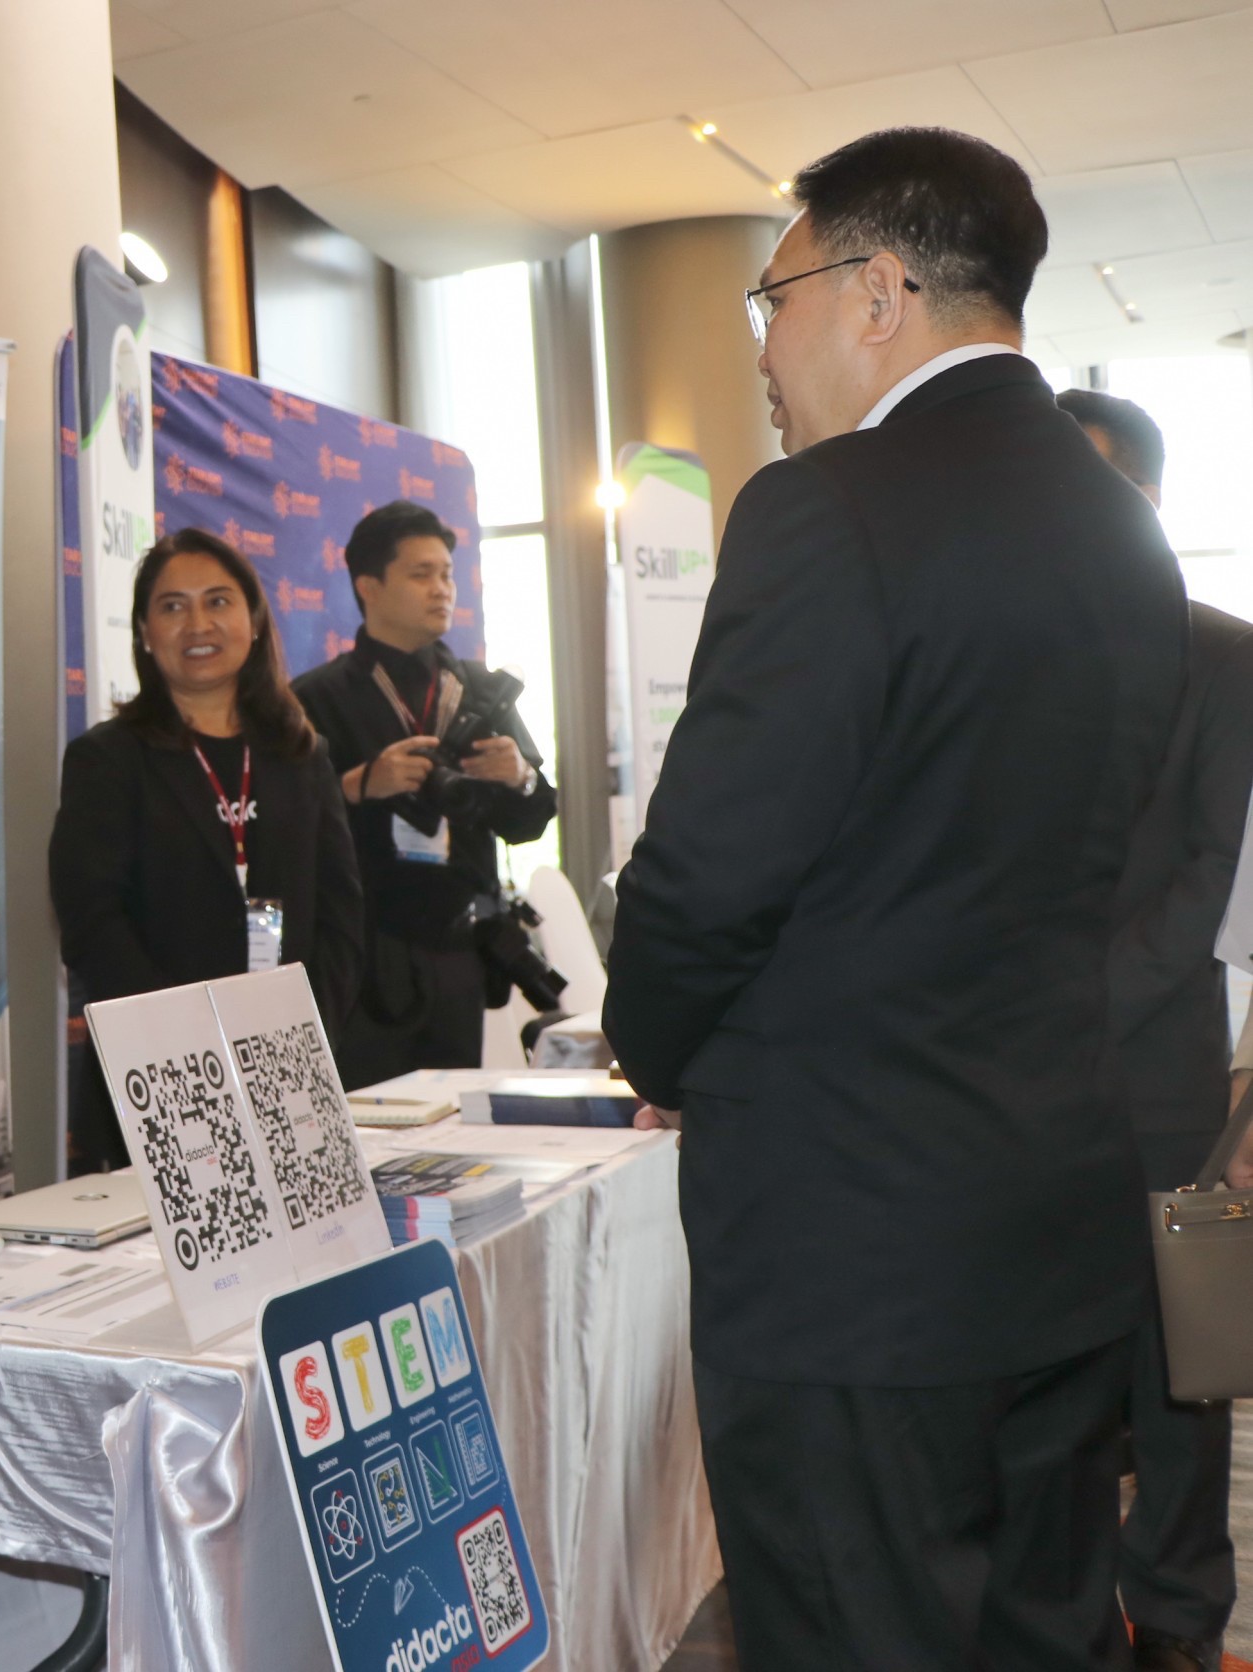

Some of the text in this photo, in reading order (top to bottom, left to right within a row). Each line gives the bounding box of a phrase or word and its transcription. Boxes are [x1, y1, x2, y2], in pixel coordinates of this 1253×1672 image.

[294, 1293, 468, 1441] STEM
[363, 1430, 392, 1448] Technology
[317, 1456, 339, 1473] Science
[385, 1603, 473, 1672] didacta
